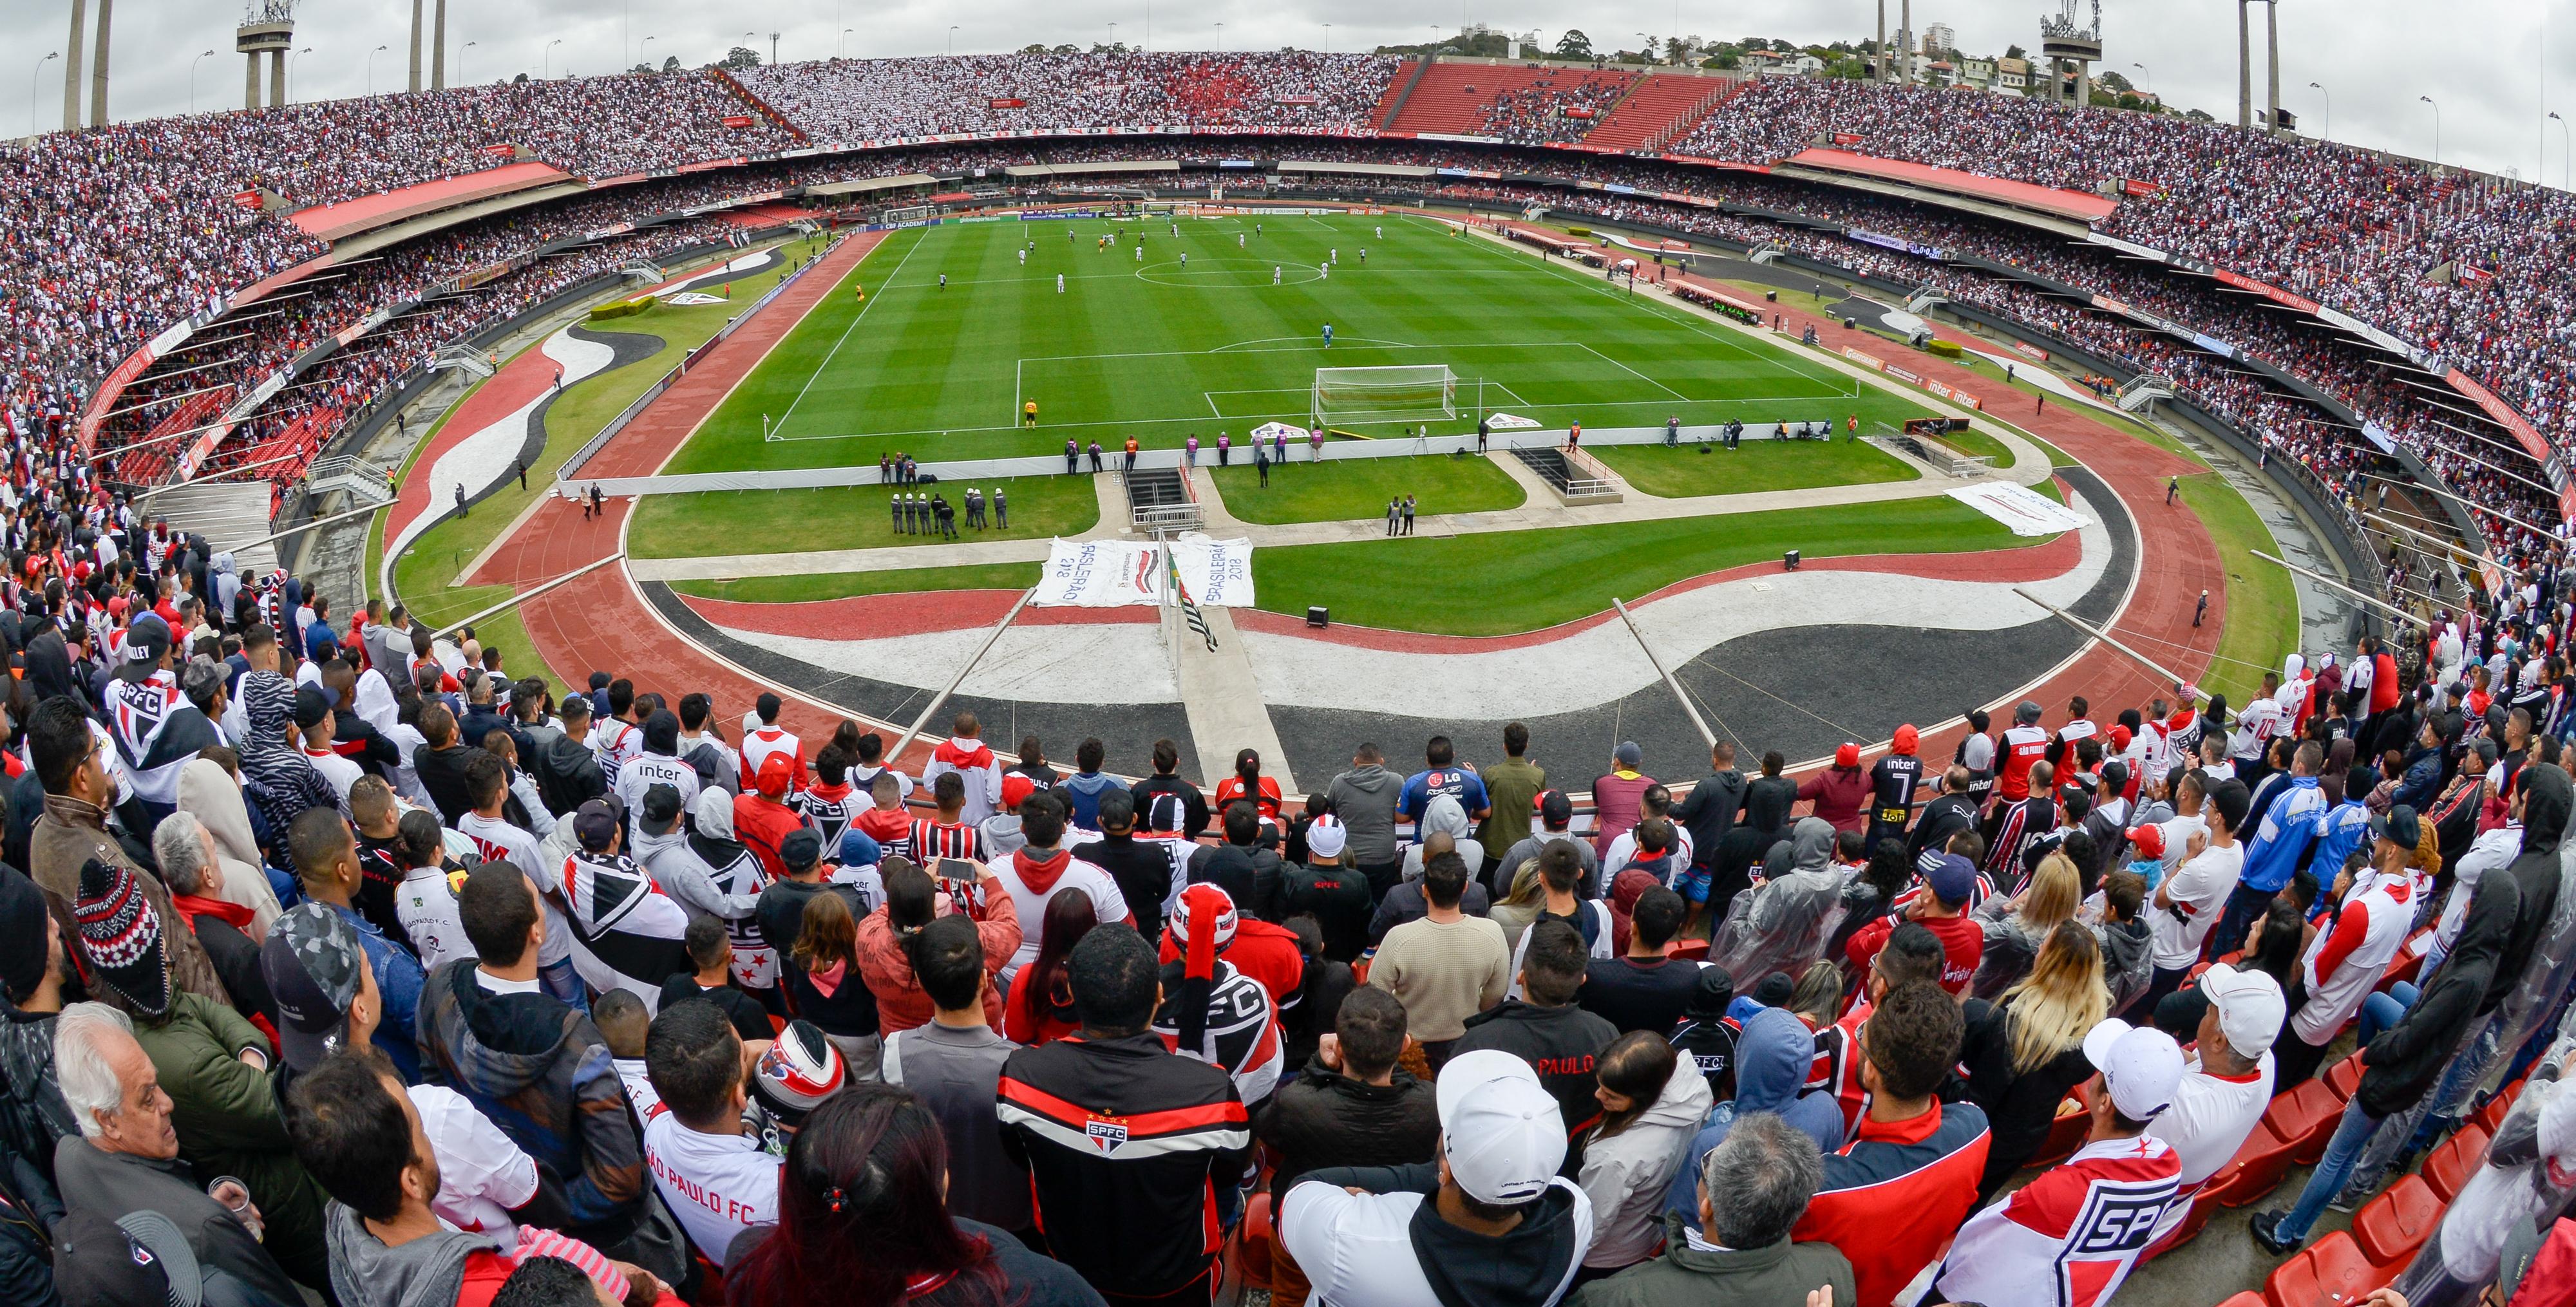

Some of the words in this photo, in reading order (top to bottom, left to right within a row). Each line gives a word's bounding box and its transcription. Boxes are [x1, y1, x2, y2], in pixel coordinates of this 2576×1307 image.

[1202, 126, 1258, 135] TORCIDA
[1329, 127, 1343, 136] DA
[831, 136, 940, 151] TORCIDA
[2118, 180, 2125, 191] 10
[898, 220, 926, 229] ACADEMY
[2246, 281, 2271, 294] CORAÇÃO
[2273, 290, 2284, 300] TEM
[2109, 300, 2125, 313] inter
[2127, 308, 2143, 319] GRAND
[2144, 314, 2161, 326] BRASIL
[2172, 326, 2193, 339] HYUNDAI
[1852, 352, 1880, 368] GATORADE
[1928, 381, 1951, 398] inter
[1954, 392, 1978, 409] inter
[1229, 558, 1243, 581] 2018
[2255, 718, 2276, 741] 10
[1886, 758, 1916, 770] inter
[639, 764, 679, 781] inter
[1445, 773, 1461, 783] LG
[1892, 773, 1909, 804] 7
[1968, 780, 1993, 793] inter
[1538, 1054, 1594, 1076] PAULO
[1090, 1125, 1126, 1138] SPFC
[645, 1143, 665, 1180] SÃO
[668, 1167, 722, 1214] PAULO
[728, 1199, 755, 1226] FC
